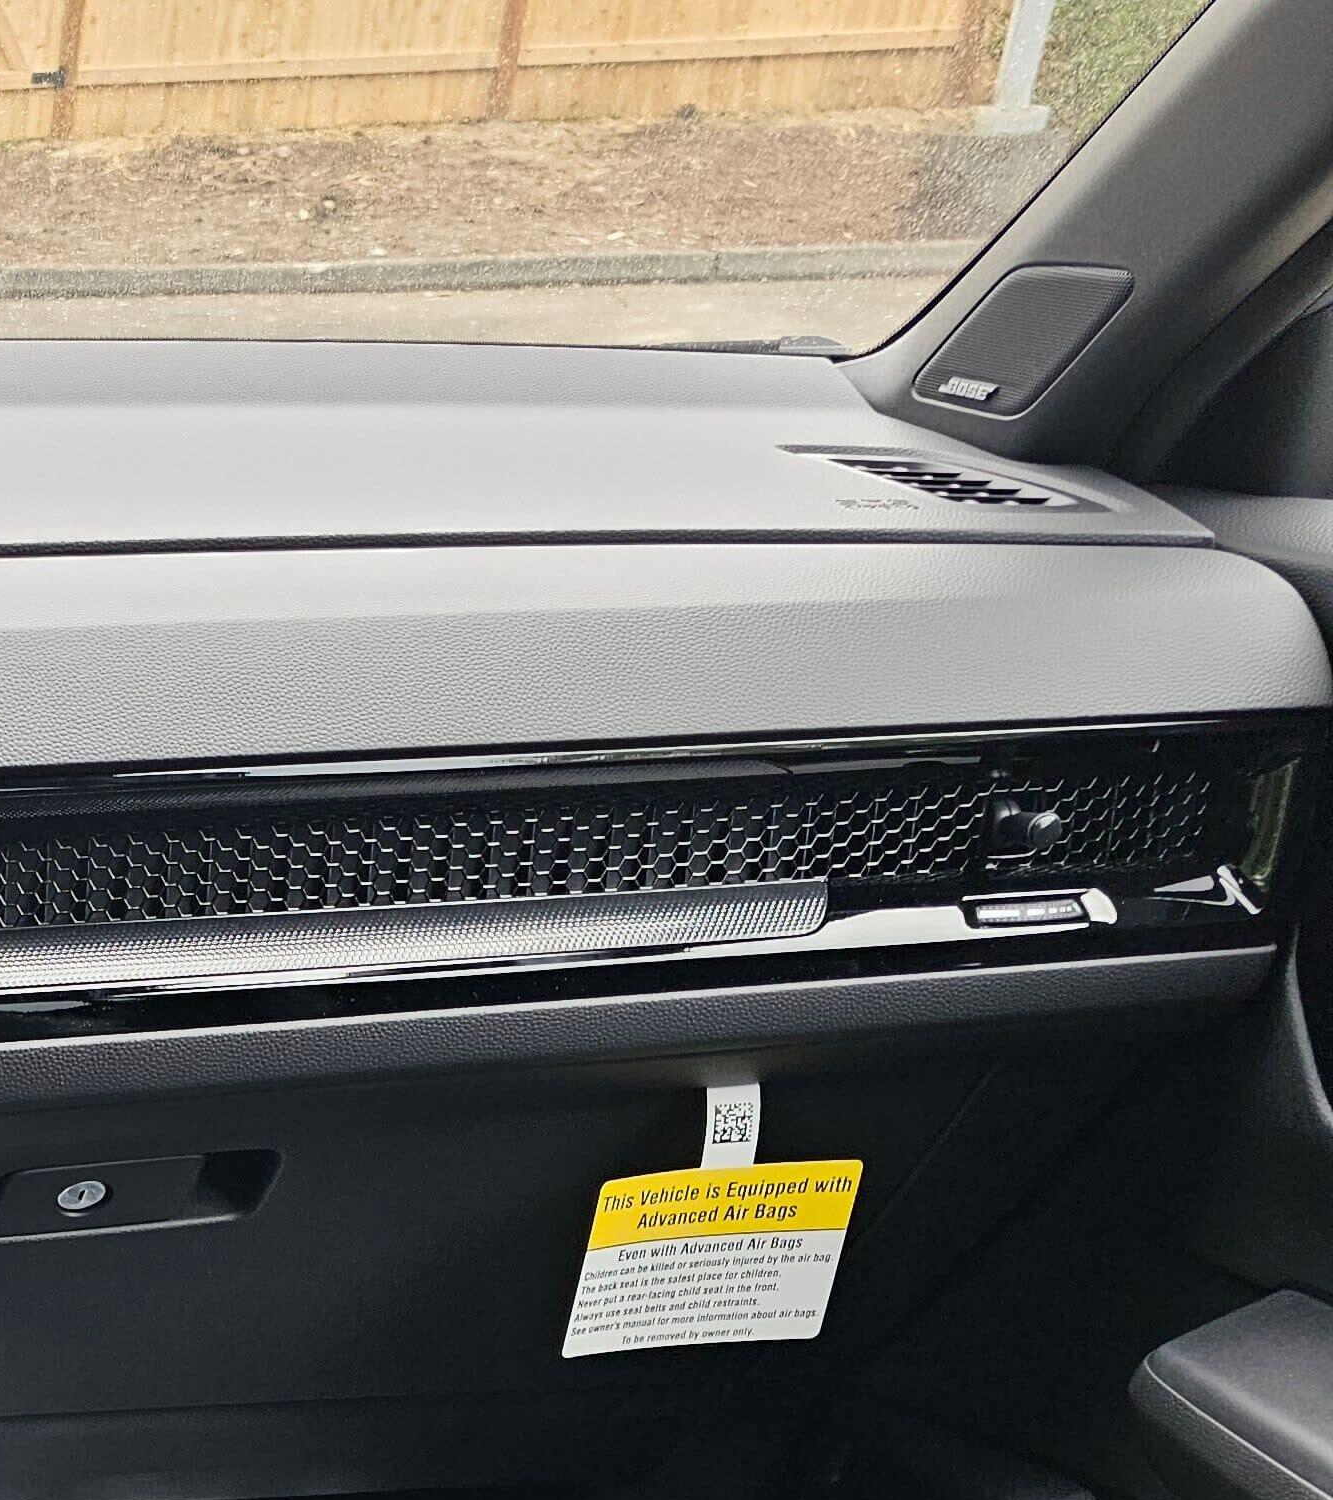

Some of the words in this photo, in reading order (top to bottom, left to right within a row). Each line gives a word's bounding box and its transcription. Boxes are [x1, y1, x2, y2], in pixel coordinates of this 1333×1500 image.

[604, 1192, 634, 1212] This
[641, 1184, 699, 1206] Vehicle
[706, 1183, 721, 1199] is
[727, 1178, 809, 1201] Equipped
[815, 1176, 852, 1193] with
[637, 1206, 719, 1229] Advanced
[723, 1205, 749, 1221] Air
[754, 1203, 798, 1222] Bags
[618, 1249, 646, 1262] Even
[651, 1244, 676, 1257] with
[680, 1239, 743, 1254] Advanced
[747, 1238, 766, 1251] Air
[770, 1236, 803, 1250] Bags
[584, 1269, 618, 1281] Children
[620, 1267, 635, 1275] can
[637, 1264, 648, 1273] be
[651, 1261, 674, 1271] killed
[677, 1261, 687, 1269] or
[689, 1257, 730, 1268] seriously
[732, 1255, 765, 1266] injured
[767, 1255, 778, 1265] by
[781, 1254, 795, 1263] the
[797, 1254, 811, 1262] air
[582, 1285, 595, 1295] The
[598, 1283, 617, 1292] back
[620, 1279, 639, 1289] seat
[641, 1277, 648, 1286] is
[651, 1276, 665, 1286] the
[667, 1273, 696, 1284] safest
[697, 1272, 722, 1283] place
[725, 1270, 738, 1280] for
[741, 1269, 782, 1279] children.
[577, 1299, 602, 1309] Never
[603, 1295, 618, 1307] put
[627, 1290, 676, 1302] rear-facing
[678, 1286, 701, 1296] child
[703, 1285, 723, 1294] seat
[725, 1285, 734, 1294] in
[737, 1284, 752, 1293] the
[754, 1283, 780, 1292] front.
[571, 1327, 586, 1337] See
[588, 1322, 620, 1333] owner's
[622, 1318, 655, 1329] manual
[657, 1316, 670, 1326] for
[671, 1315, 694, 1324] more
[697, 1311, 749, 1323] information
[751, 1310, 777, 1320] about
[779, 1309, 792, 1318] air
[574, 1312, 603, 1323] Always
[605, 1309, 621, 1318] use
[623, 1305, 642, 1316] seat
[644, 1303, 666, 1313] belts
[669, 1302, 685, 1311] and
[688, 1299, 710, 1310] child
[713, 1297, 760, 1308] restraints.
[622, 1335, 631, 1345] To
[633, 1334, 644, 1343] be
[647, 1330, 686, 1341] removed
[689, 1329, 700, 1339] by
[702, 1327, 733, 1338] owner
